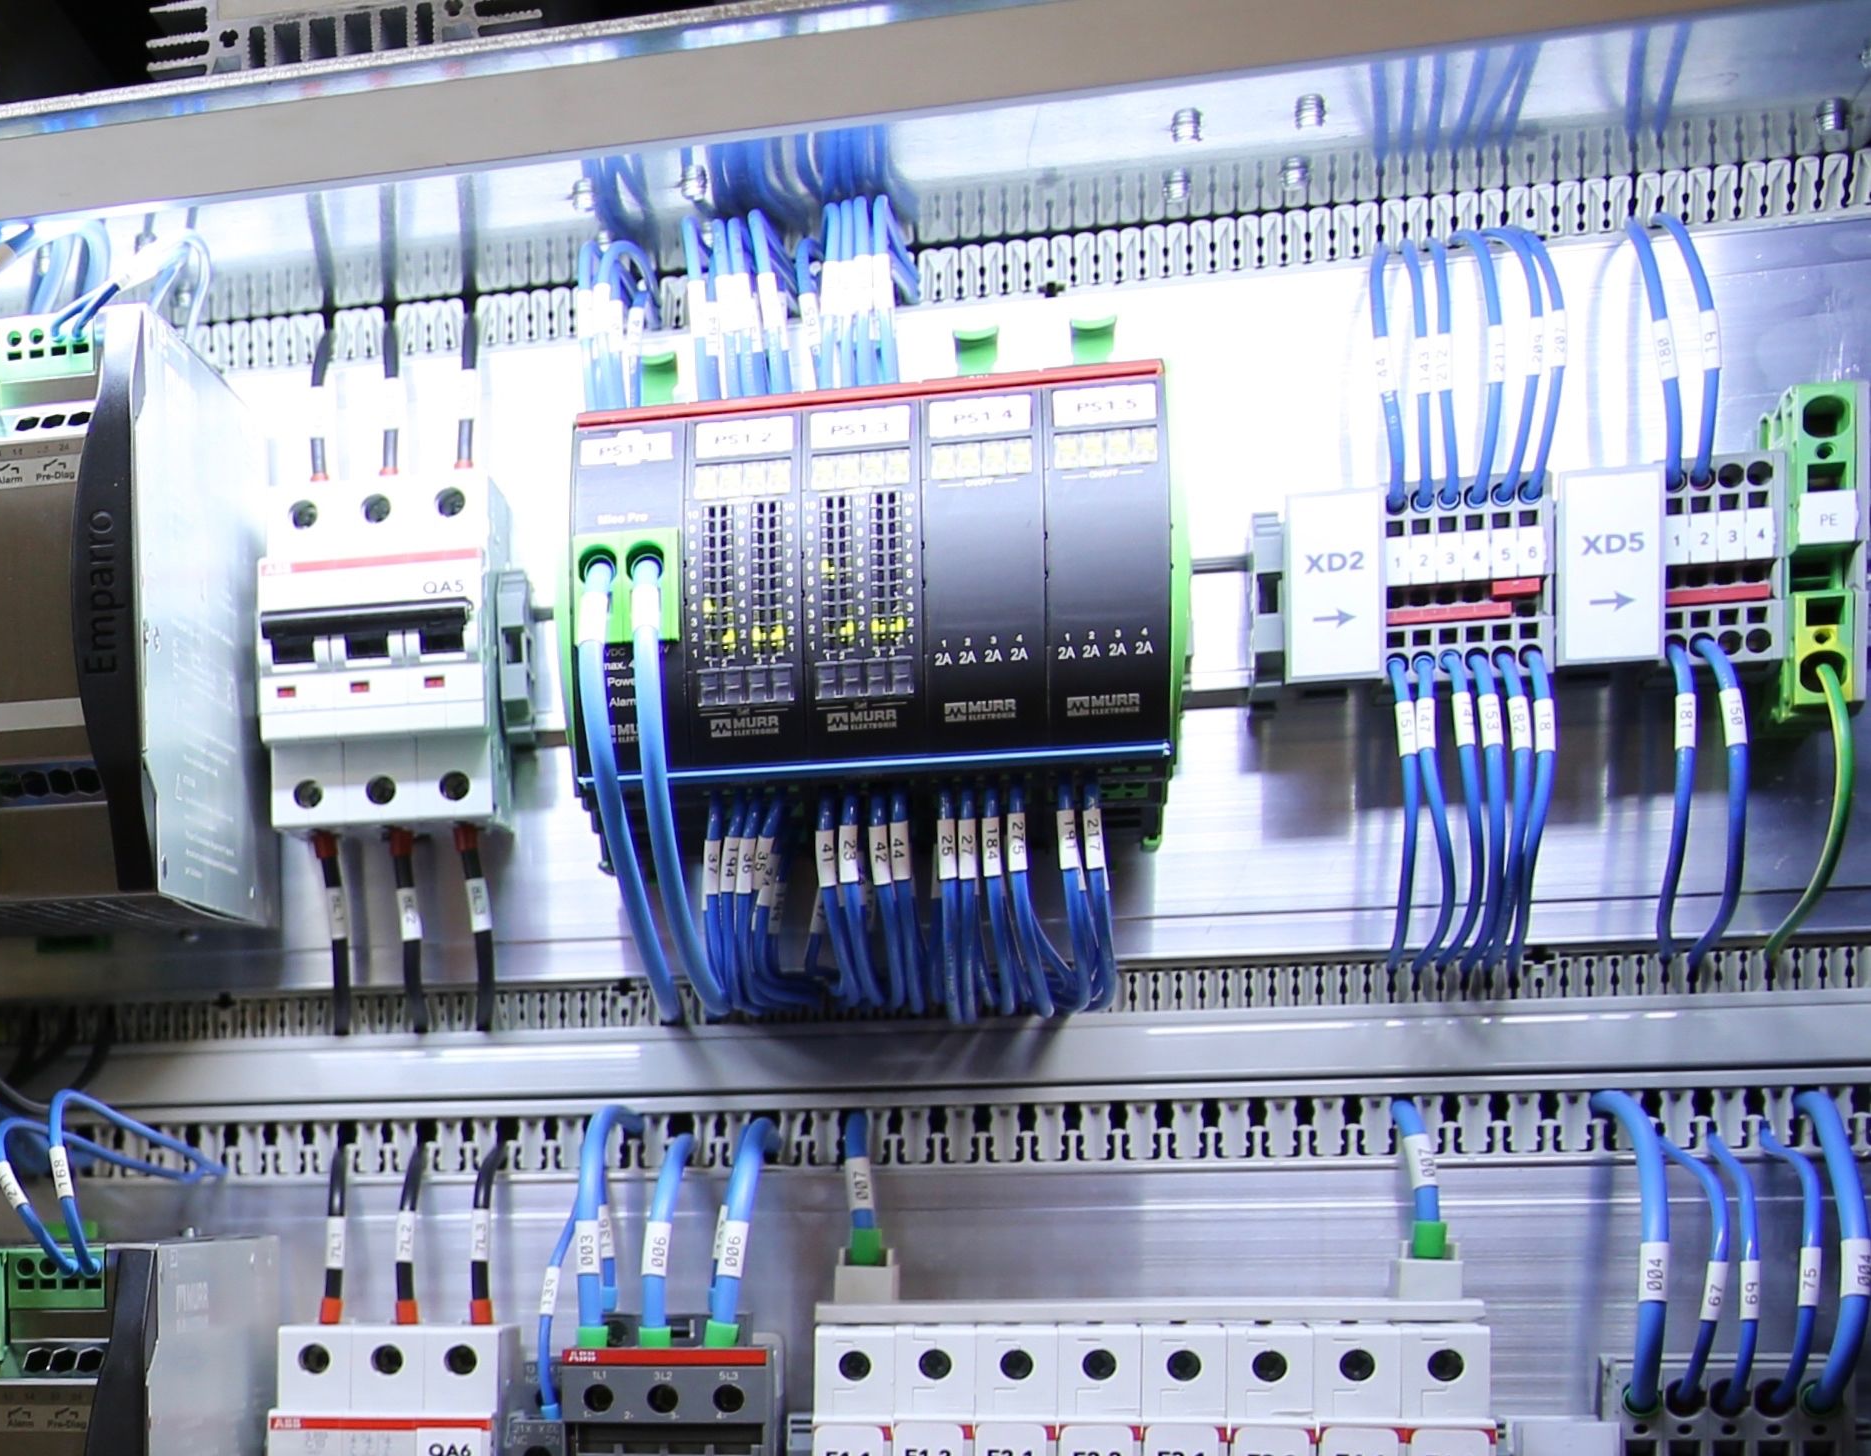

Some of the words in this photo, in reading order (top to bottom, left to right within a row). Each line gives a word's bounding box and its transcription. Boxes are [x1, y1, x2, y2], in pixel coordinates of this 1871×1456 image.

[37, 471, 77, 482] Pre-Diag
[1820, 514, 1838, 527] PE
[1581, 532, 1645, 556] XD5
[1675, 536, 1680, 547] 1
[1700, 533, 1710, 545] 2
[1729, 531, 1738, 543] 3
[1757, 528, 1765, 540] 4
[1305, 551, 1365, 574] XD2
[1420, 555, 1429, 567] 2
[1446, 552, 1456, 564] 3
[1474, 550, 1482, 561] 4
[1502, 549, 1511, 560] 5
[1529, 546, 1537, 558] 6
[84, 510, 126, 675] Emparro
[423, 580, 465, 595] QA5
[935, 654, 952, 666] 2A
[960, 652, 976, 664] 2A
[985, 651, 1002, 663] 2A
[1011, 649, 1028, 662] 2A
[1059, 647, 1076, 660] 2A
[1083, 646, 1100, 658] 2A
[1110, 644, 1127, 657] 2A
[1137, 643, 1154, 655] 2A
[968, 700, 1016, 713] MURR
[1092, 695, 1140, 708] MURR
[733, 717, 779, 730] MURR
[851, 711, 898, 724] MURR
[941, 835, 953, 856] 25
[961, 835, 974, 855] 27
[986, 829, 998, 860] 184
[1012, 821, 1025, 854] 275
[822, 844, 834, 863] 41
[843, 840, 857, 860] 23
[877, 841, 888, 863] 42
[893, 838, 905, 860] 44
[742, 854, 751, 873] 36
[55, 1159, 69, 1187] 168
[400, 1224, 413, 1253] 7L2
[476, 1224, 488, 1251] 7L3
[580, 1235, 594, 1266] 003
[652, 1236, 667, 1268] 006
[726, 1236, 742, 1268] 006
[1648, 1258, 1664, 1291] 004
[1804, 1267, 1817, 1290] 75
[1709, 1285, 1724, 1307] 67
[1746, 1282, 1758, 1306] 69
[569, 1351, 596, 1362] ABB
[273, 1418, 302, 1429] ABB
